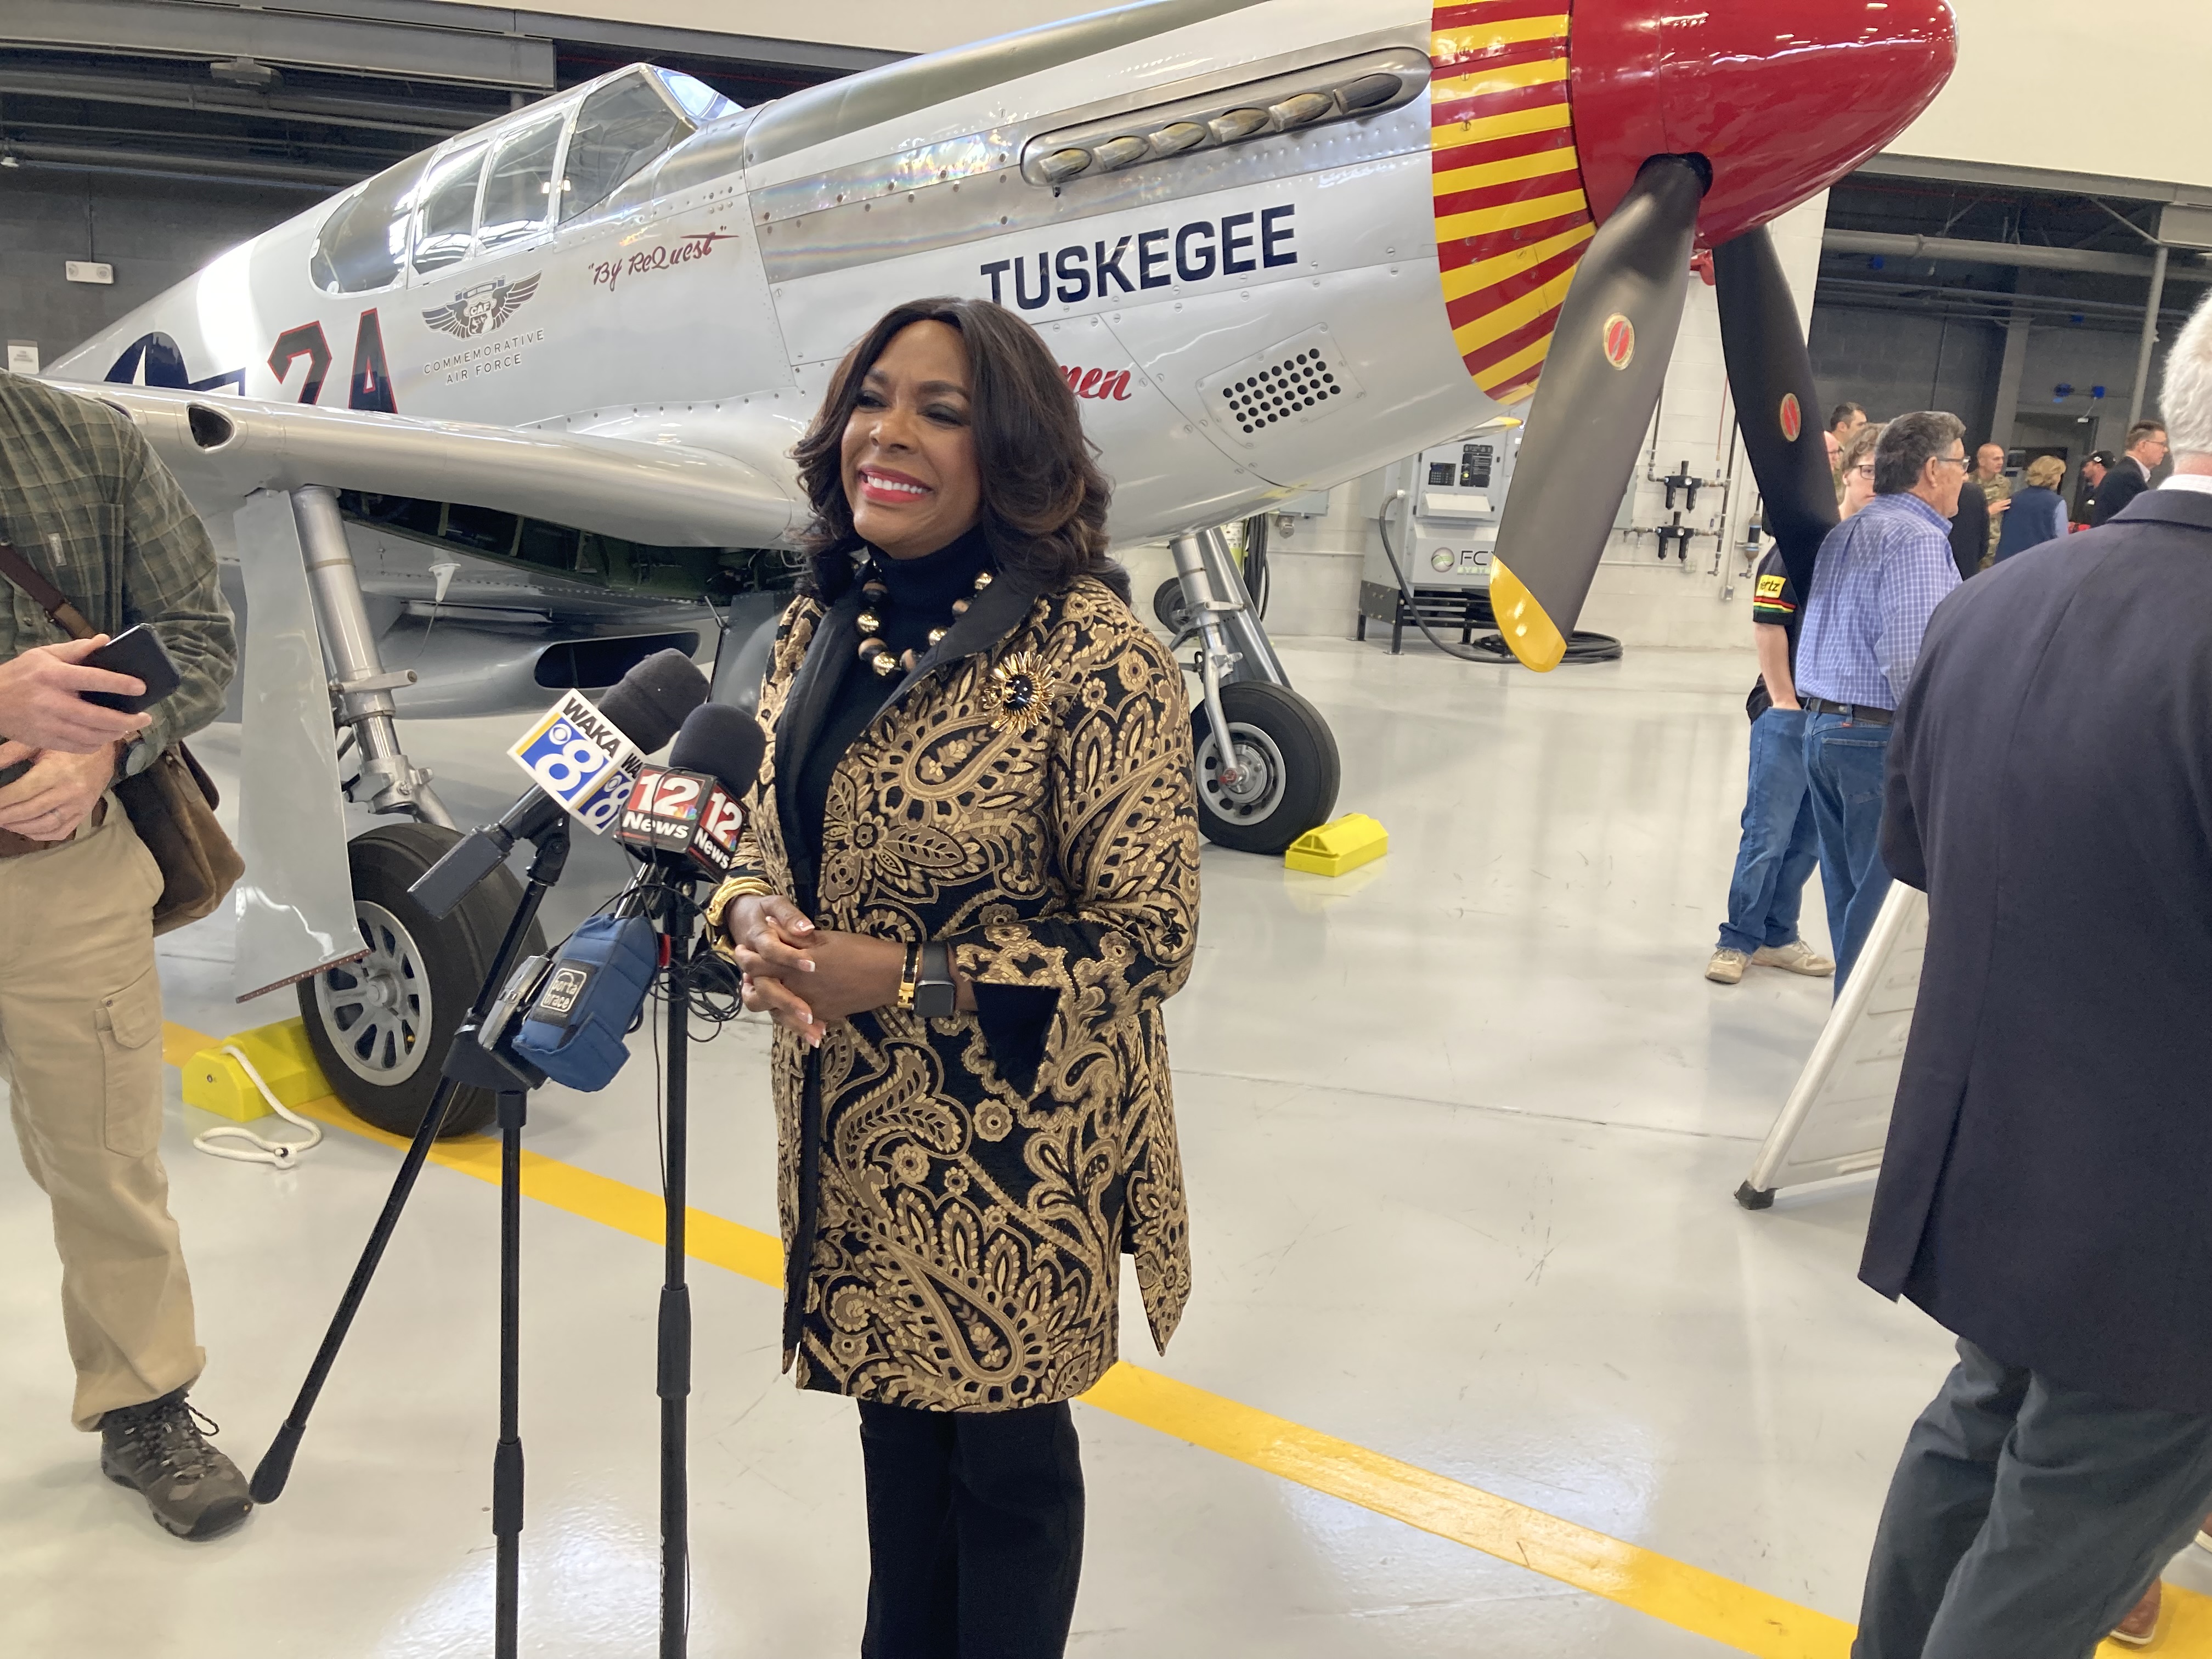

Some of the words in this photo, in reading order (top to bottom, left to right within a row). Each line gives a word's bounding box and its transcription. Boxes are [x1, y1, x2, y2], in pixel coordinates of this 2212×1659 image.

[980, 204, 1297, 310] TUSKEGEE
[470, 302, 490, 315] CAF
[424, 330, 544, 374] COMMEMORATIVE
[447, 370, 468, 384] AIR
[476, 354, 521, 376] FORCE
[1460, 550, 1494, 566] FC
[563, 697, 621, 758] WAKA
[534, 739, 604, 792] 8
[638, 774, 700, 816] 12
[622, 811, 690, 839] News
[705, 792, 743, 843] 12
[693, 827, 730, 870] News
